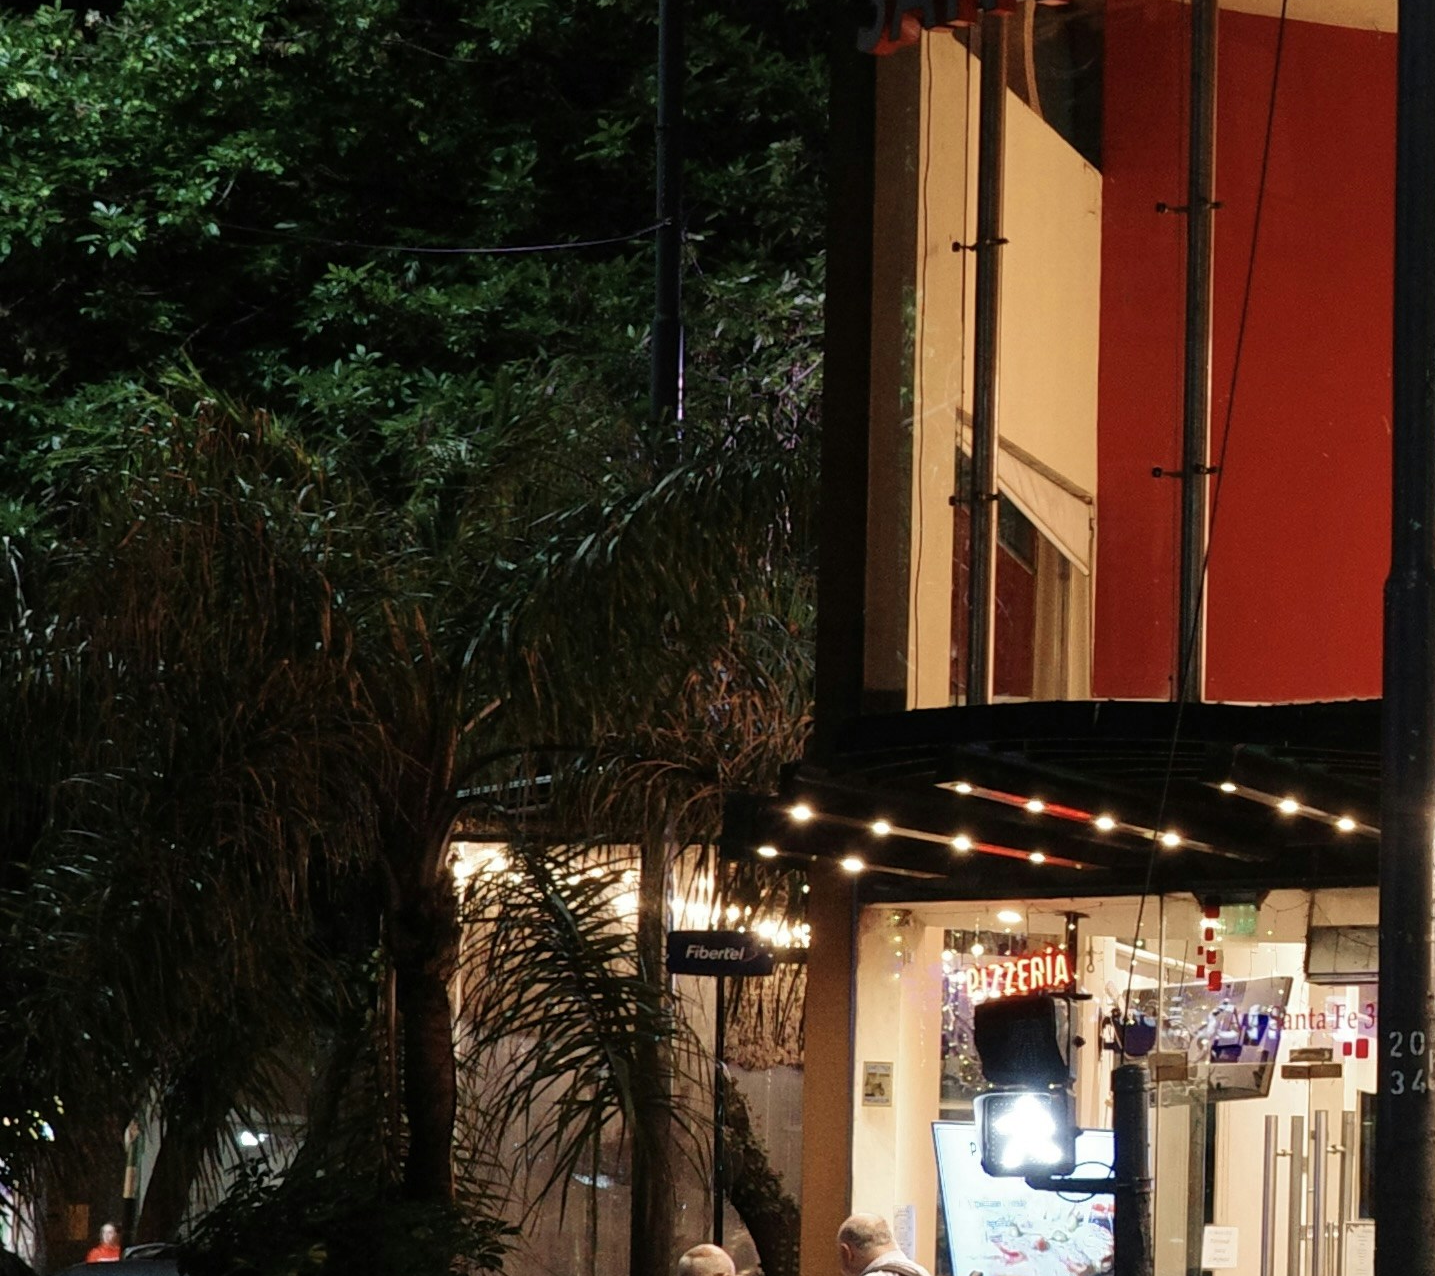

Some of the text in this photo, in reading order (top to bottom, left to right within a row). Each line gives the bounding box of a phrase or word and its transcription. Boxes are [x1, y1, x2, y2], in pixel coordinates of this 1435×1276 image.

[684, 943, 746, 961] Fibertel
[1270, 1004, 1326, 1030] Santa
[1332, 1003, 1358, 1029] Fe
